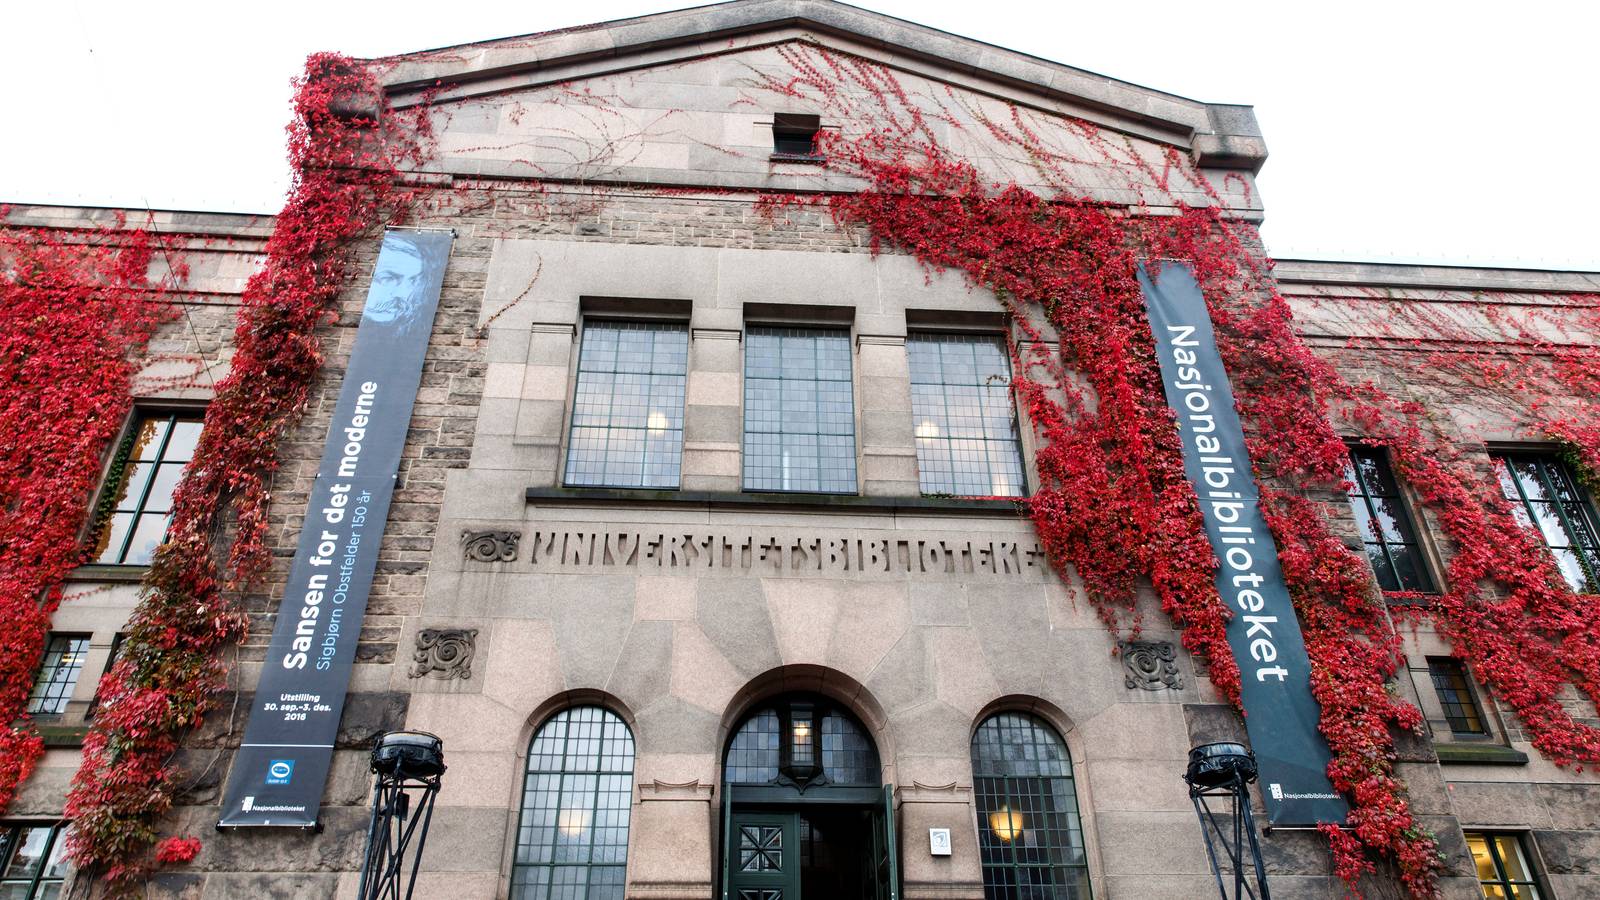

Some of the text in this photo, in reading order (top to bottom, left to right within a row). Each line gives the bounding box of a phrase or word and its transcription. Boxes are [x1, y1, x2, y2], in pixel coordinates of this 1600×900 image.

[1167, 325, 1289, 682] Nasjonalbiblioteket
[282, 381, 378, 670] Sansen for det moderne
[316, 489, 373, 671] Sigbjørn Obstfelder 150 år
[280, 693, 321, 703] Utstilling
[263, 703, 279, 711] 30.
[313, 703, 332, 712] des.
[284, 712, 307, 721] 2016
[252, 805, 306, 813] Nasjonalbiblioteket
